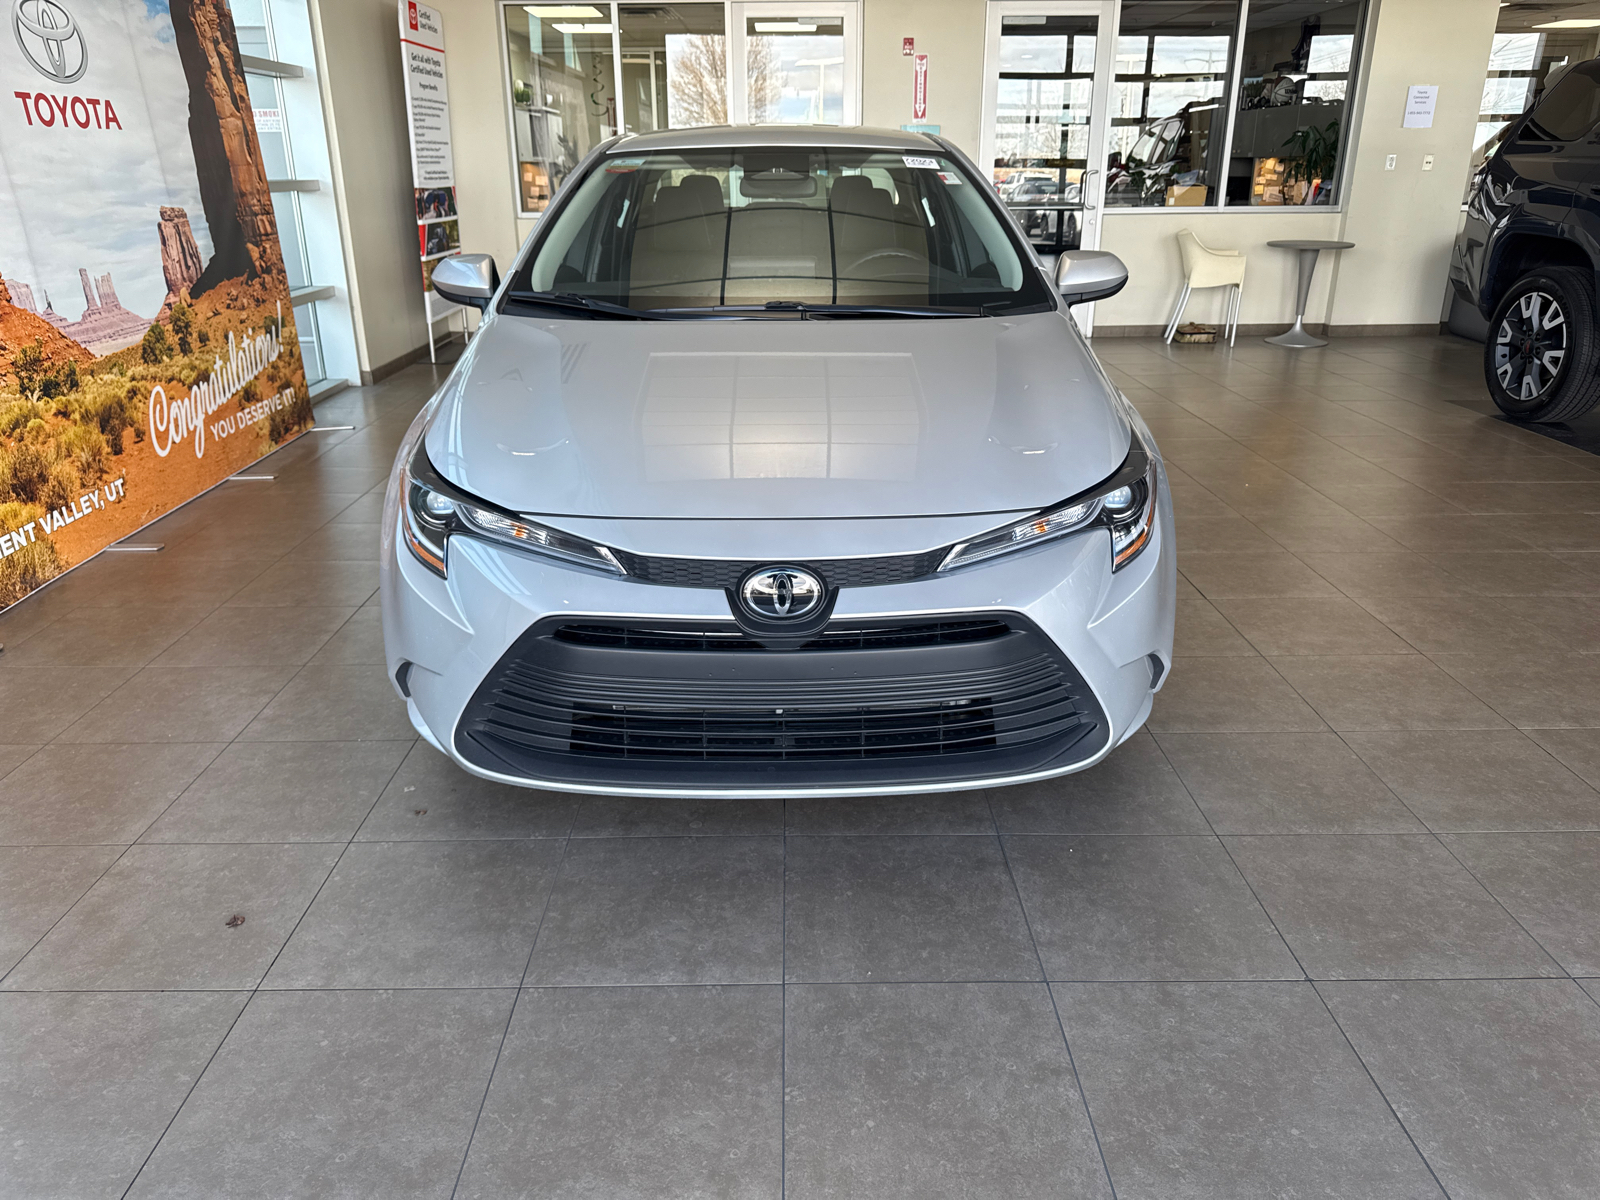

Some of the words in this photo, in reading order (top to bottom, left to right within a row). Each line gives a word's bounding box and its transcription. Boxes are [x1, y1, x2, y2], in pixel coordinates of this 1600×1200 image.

[14, 91, 122, 130] TOYOTA
[149, 299, 284, 459] Congratulations!
[210, 415, 236, 441] YOU
[236, 393, 283, 429] DESERVE
[282, 386, 297, 407] IT!
[0, 521, 36, 559] ENT
[38, 489, 106, 535] VALLEY,
[104, 478, 125, 502] UT
